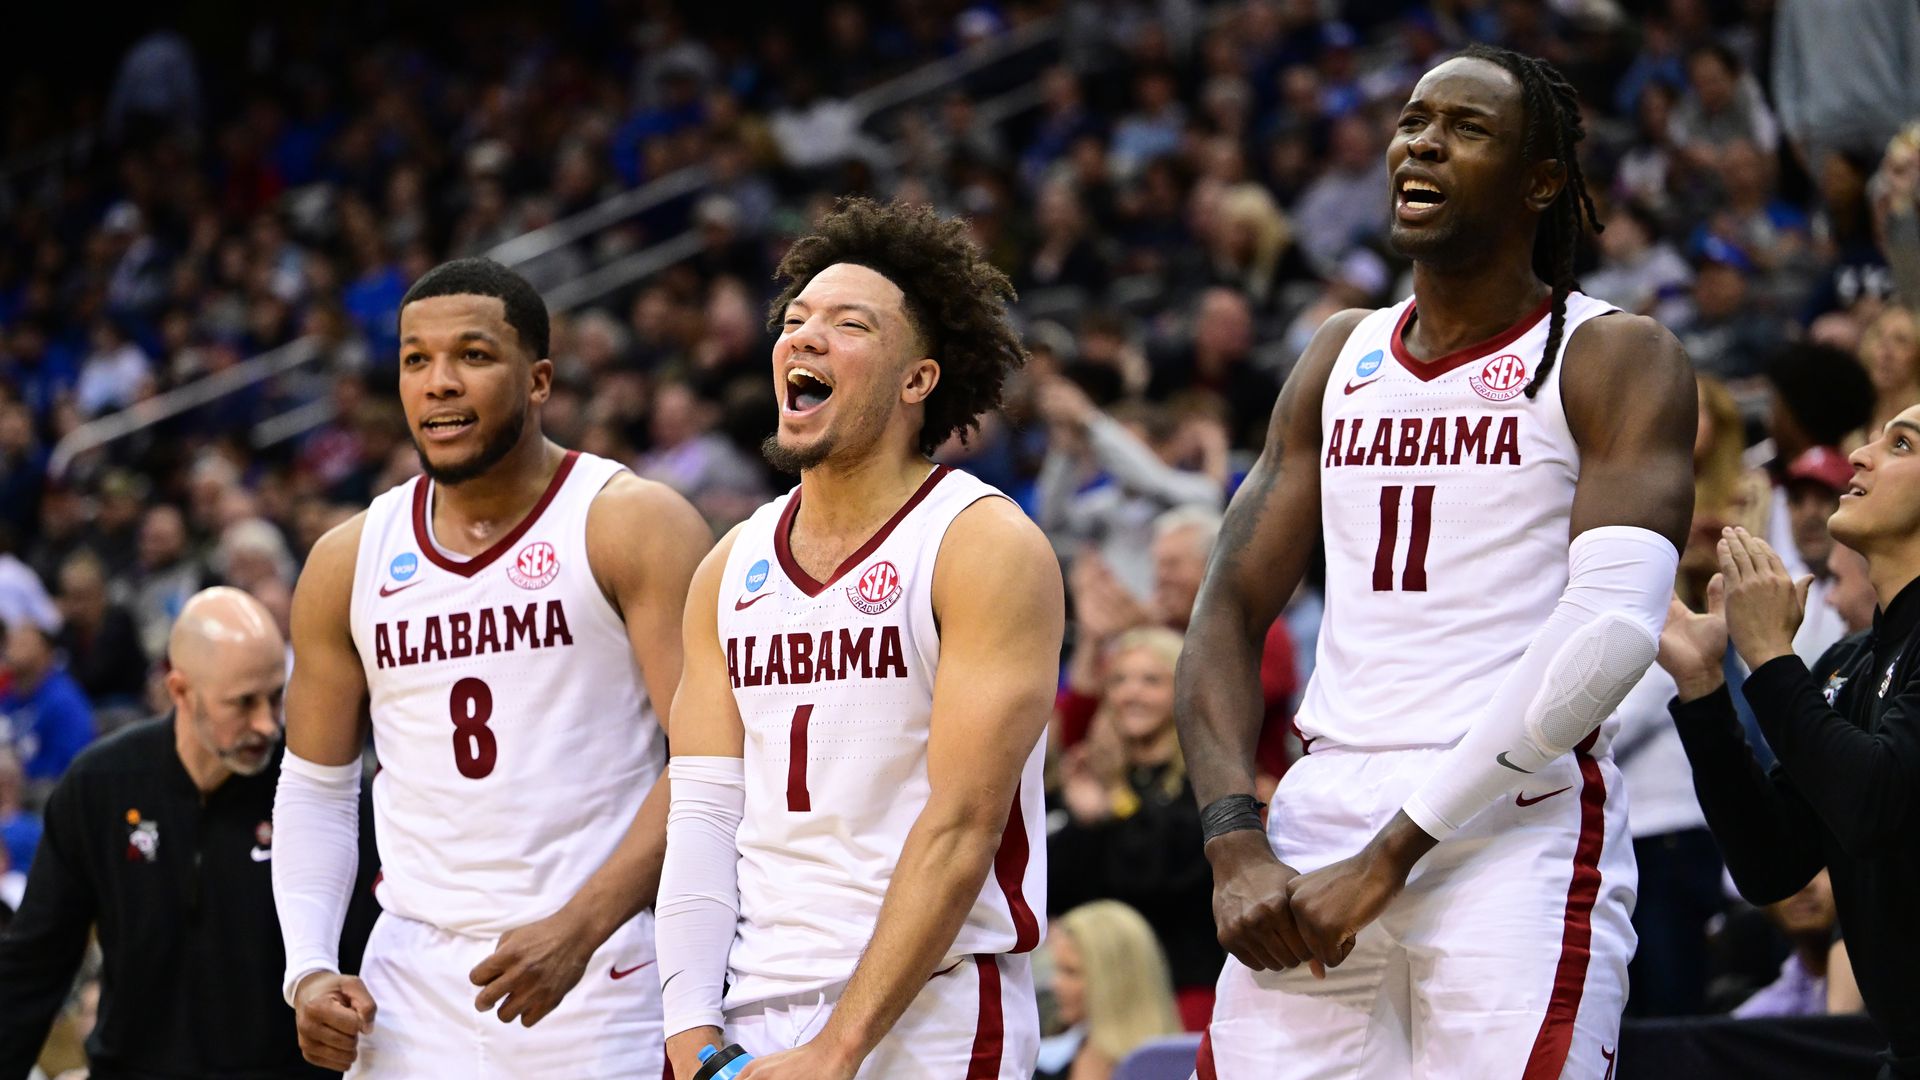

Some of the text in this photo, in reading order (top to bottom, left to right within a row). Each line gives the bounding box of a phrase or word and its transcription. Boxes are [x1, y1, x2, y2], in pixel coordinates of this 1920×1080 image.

[1483, 356, 1524, 389] SEC
[1325, 416, 1522, 469] ALABAMA
[518, 543, 555, 577] SEC
[1372, 485, 1436, 592] 11
[851, 595, 894, 613] GRADUATE
[860, 563, 898, 601] SEC
[375, 599, 574, 670] ALABAMA
[727, 625, 908, 690] ALABAMA
[449, 676, 498, 780] 8
[786, 703, 815, 812] 1
